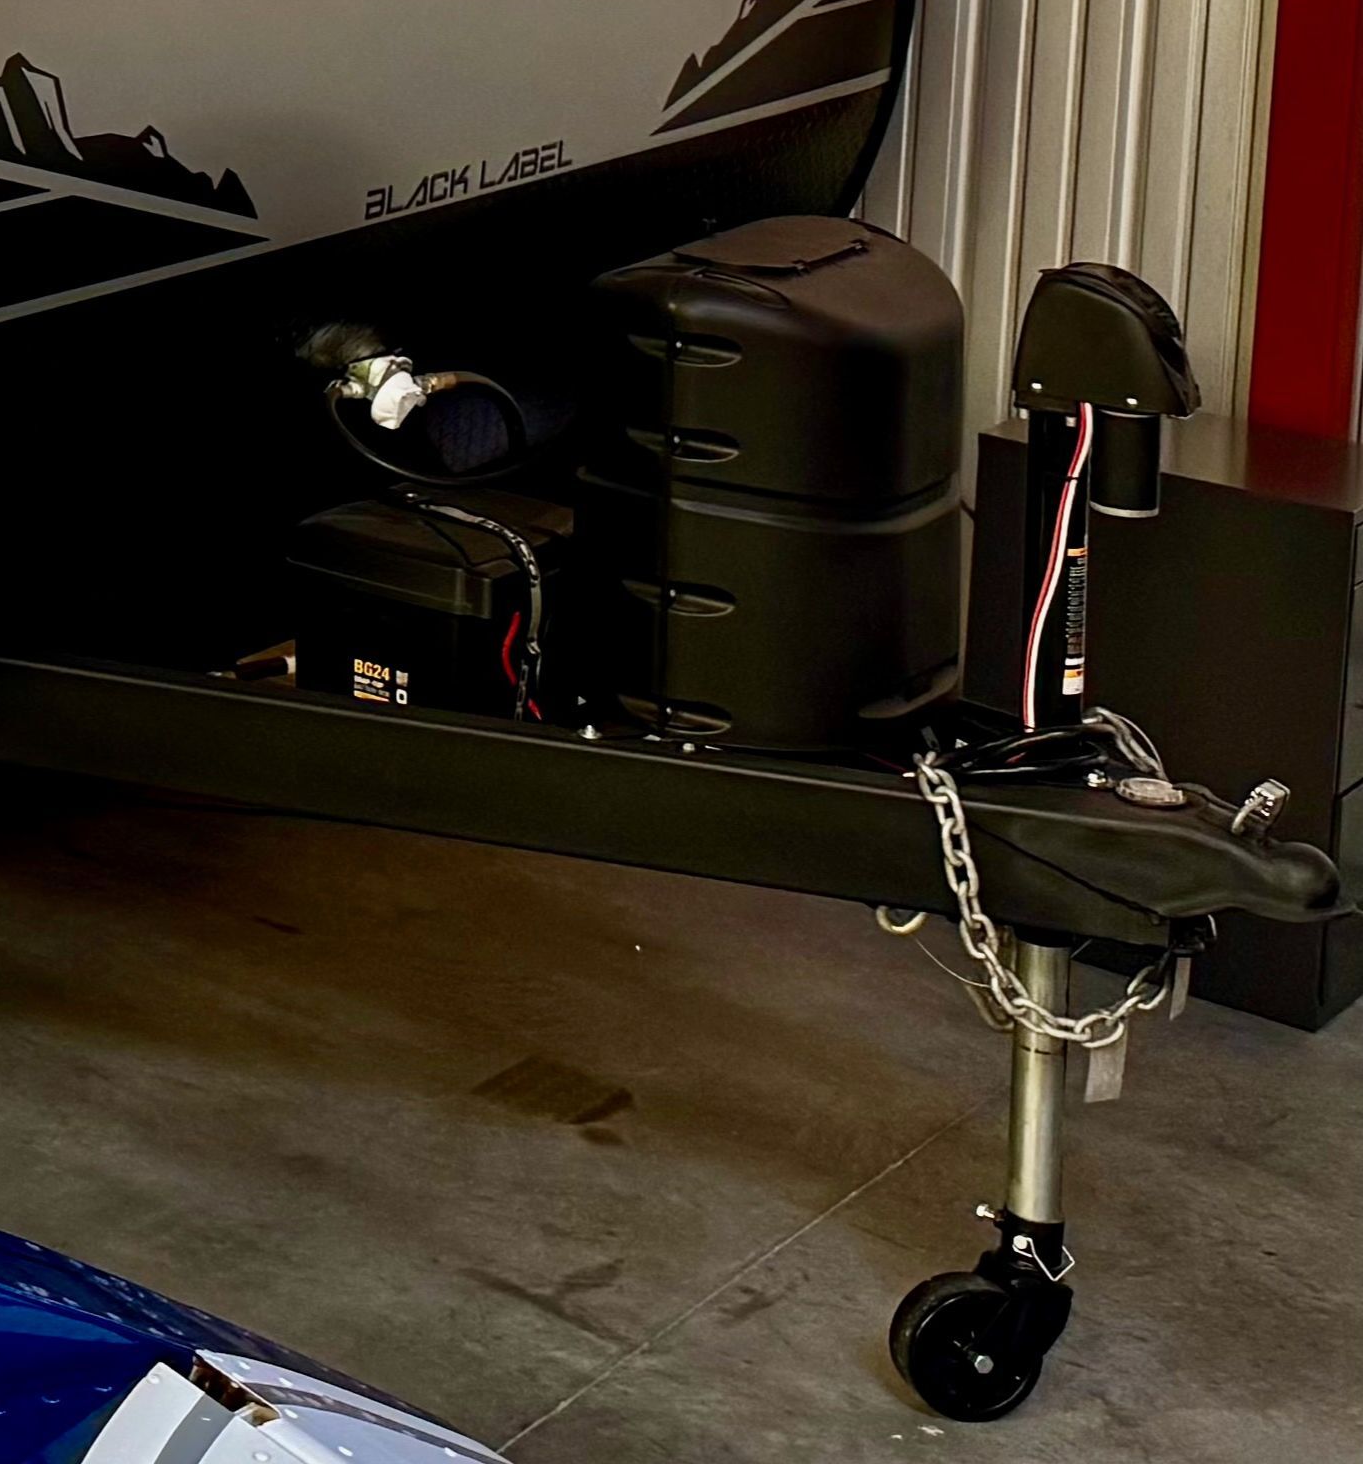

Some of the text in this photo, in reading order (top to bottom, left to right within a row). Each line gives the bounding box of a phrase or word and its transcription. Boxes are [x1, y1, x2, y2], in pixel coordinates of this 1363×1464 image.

[364, 139, 574, 221] BLACK LABEL
[354, 658, 390, 682] BG24
